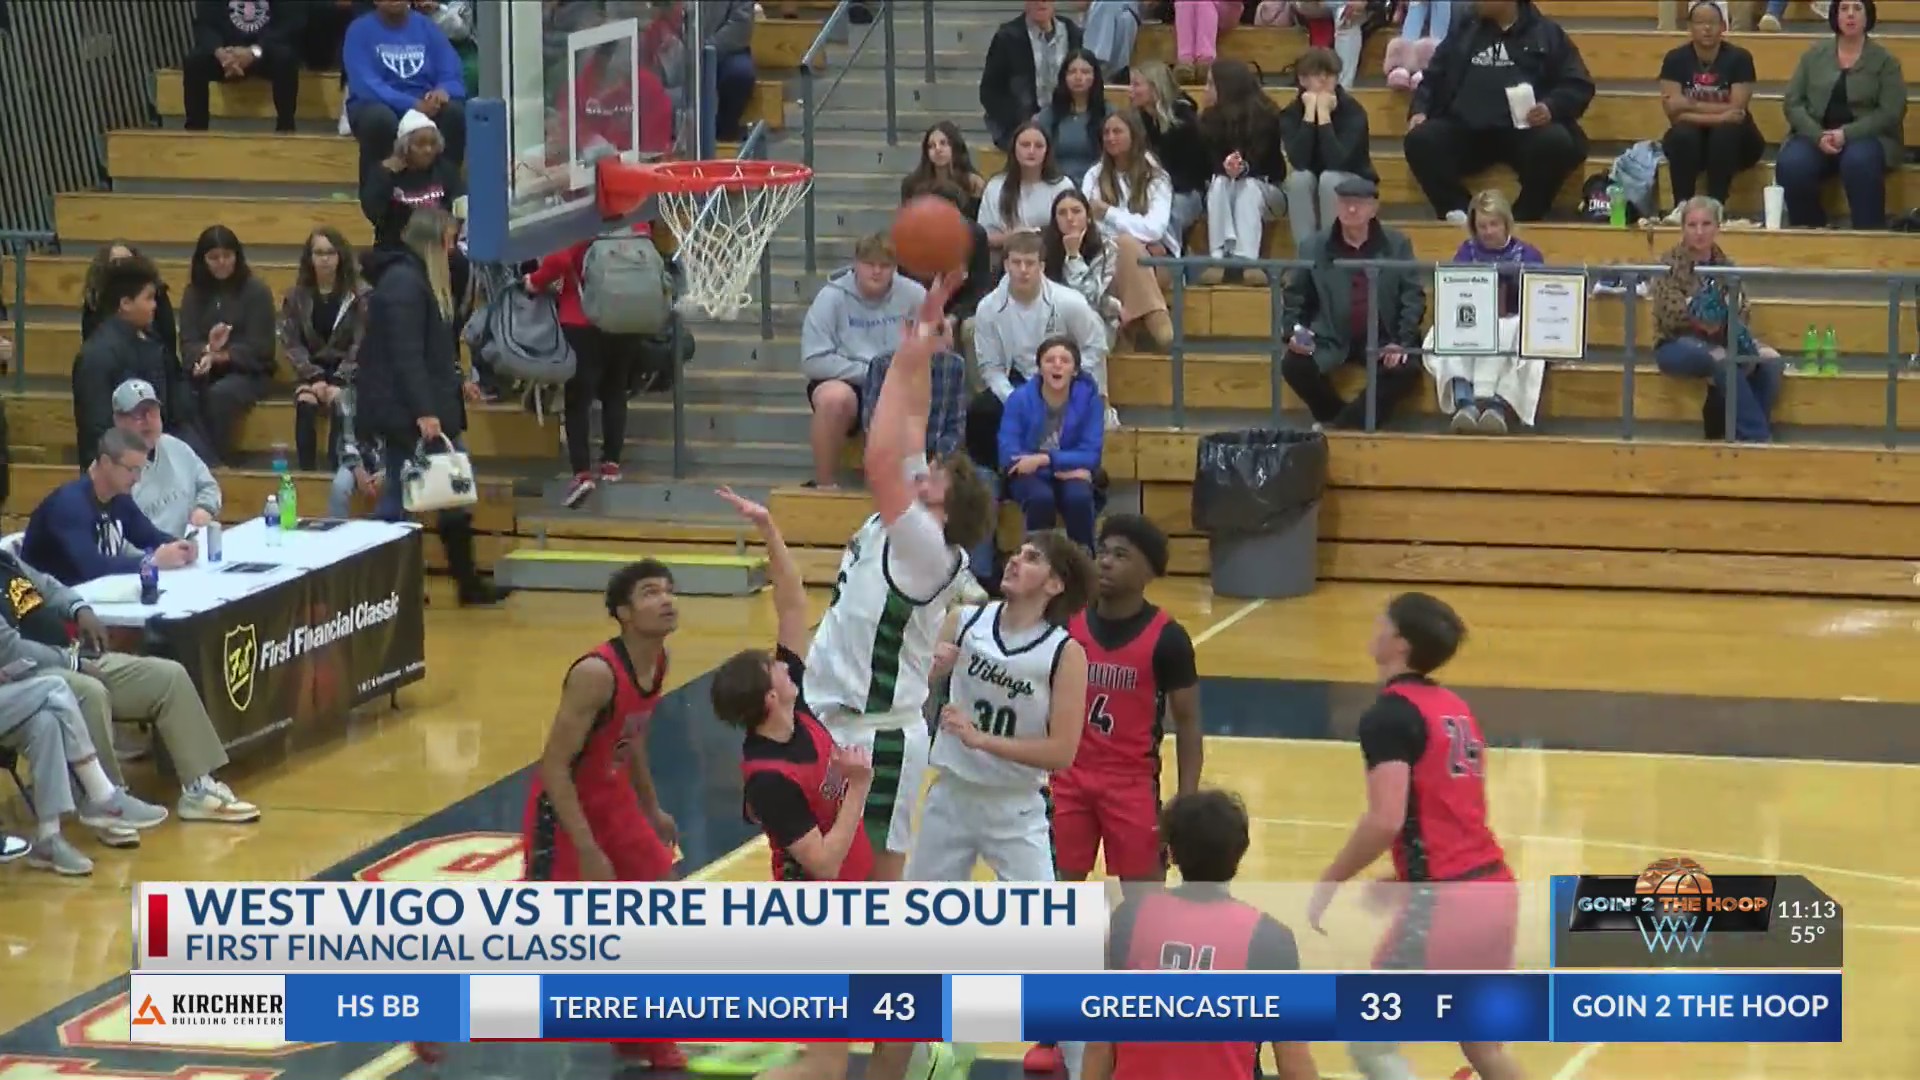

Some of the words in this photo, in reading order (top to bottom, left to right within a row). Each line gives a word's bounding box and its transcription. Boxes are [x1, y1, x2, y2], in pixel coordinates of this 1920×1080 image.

[259, 635, 292, 671] First
[294, 607, 355, 655] Financial
[355, 591, 400, 629] Classic
[967, 652, 1034, 699] Vikings
[1087, 662, 1138, 690] OUTH
[971, 699, 1018, 738] 30
